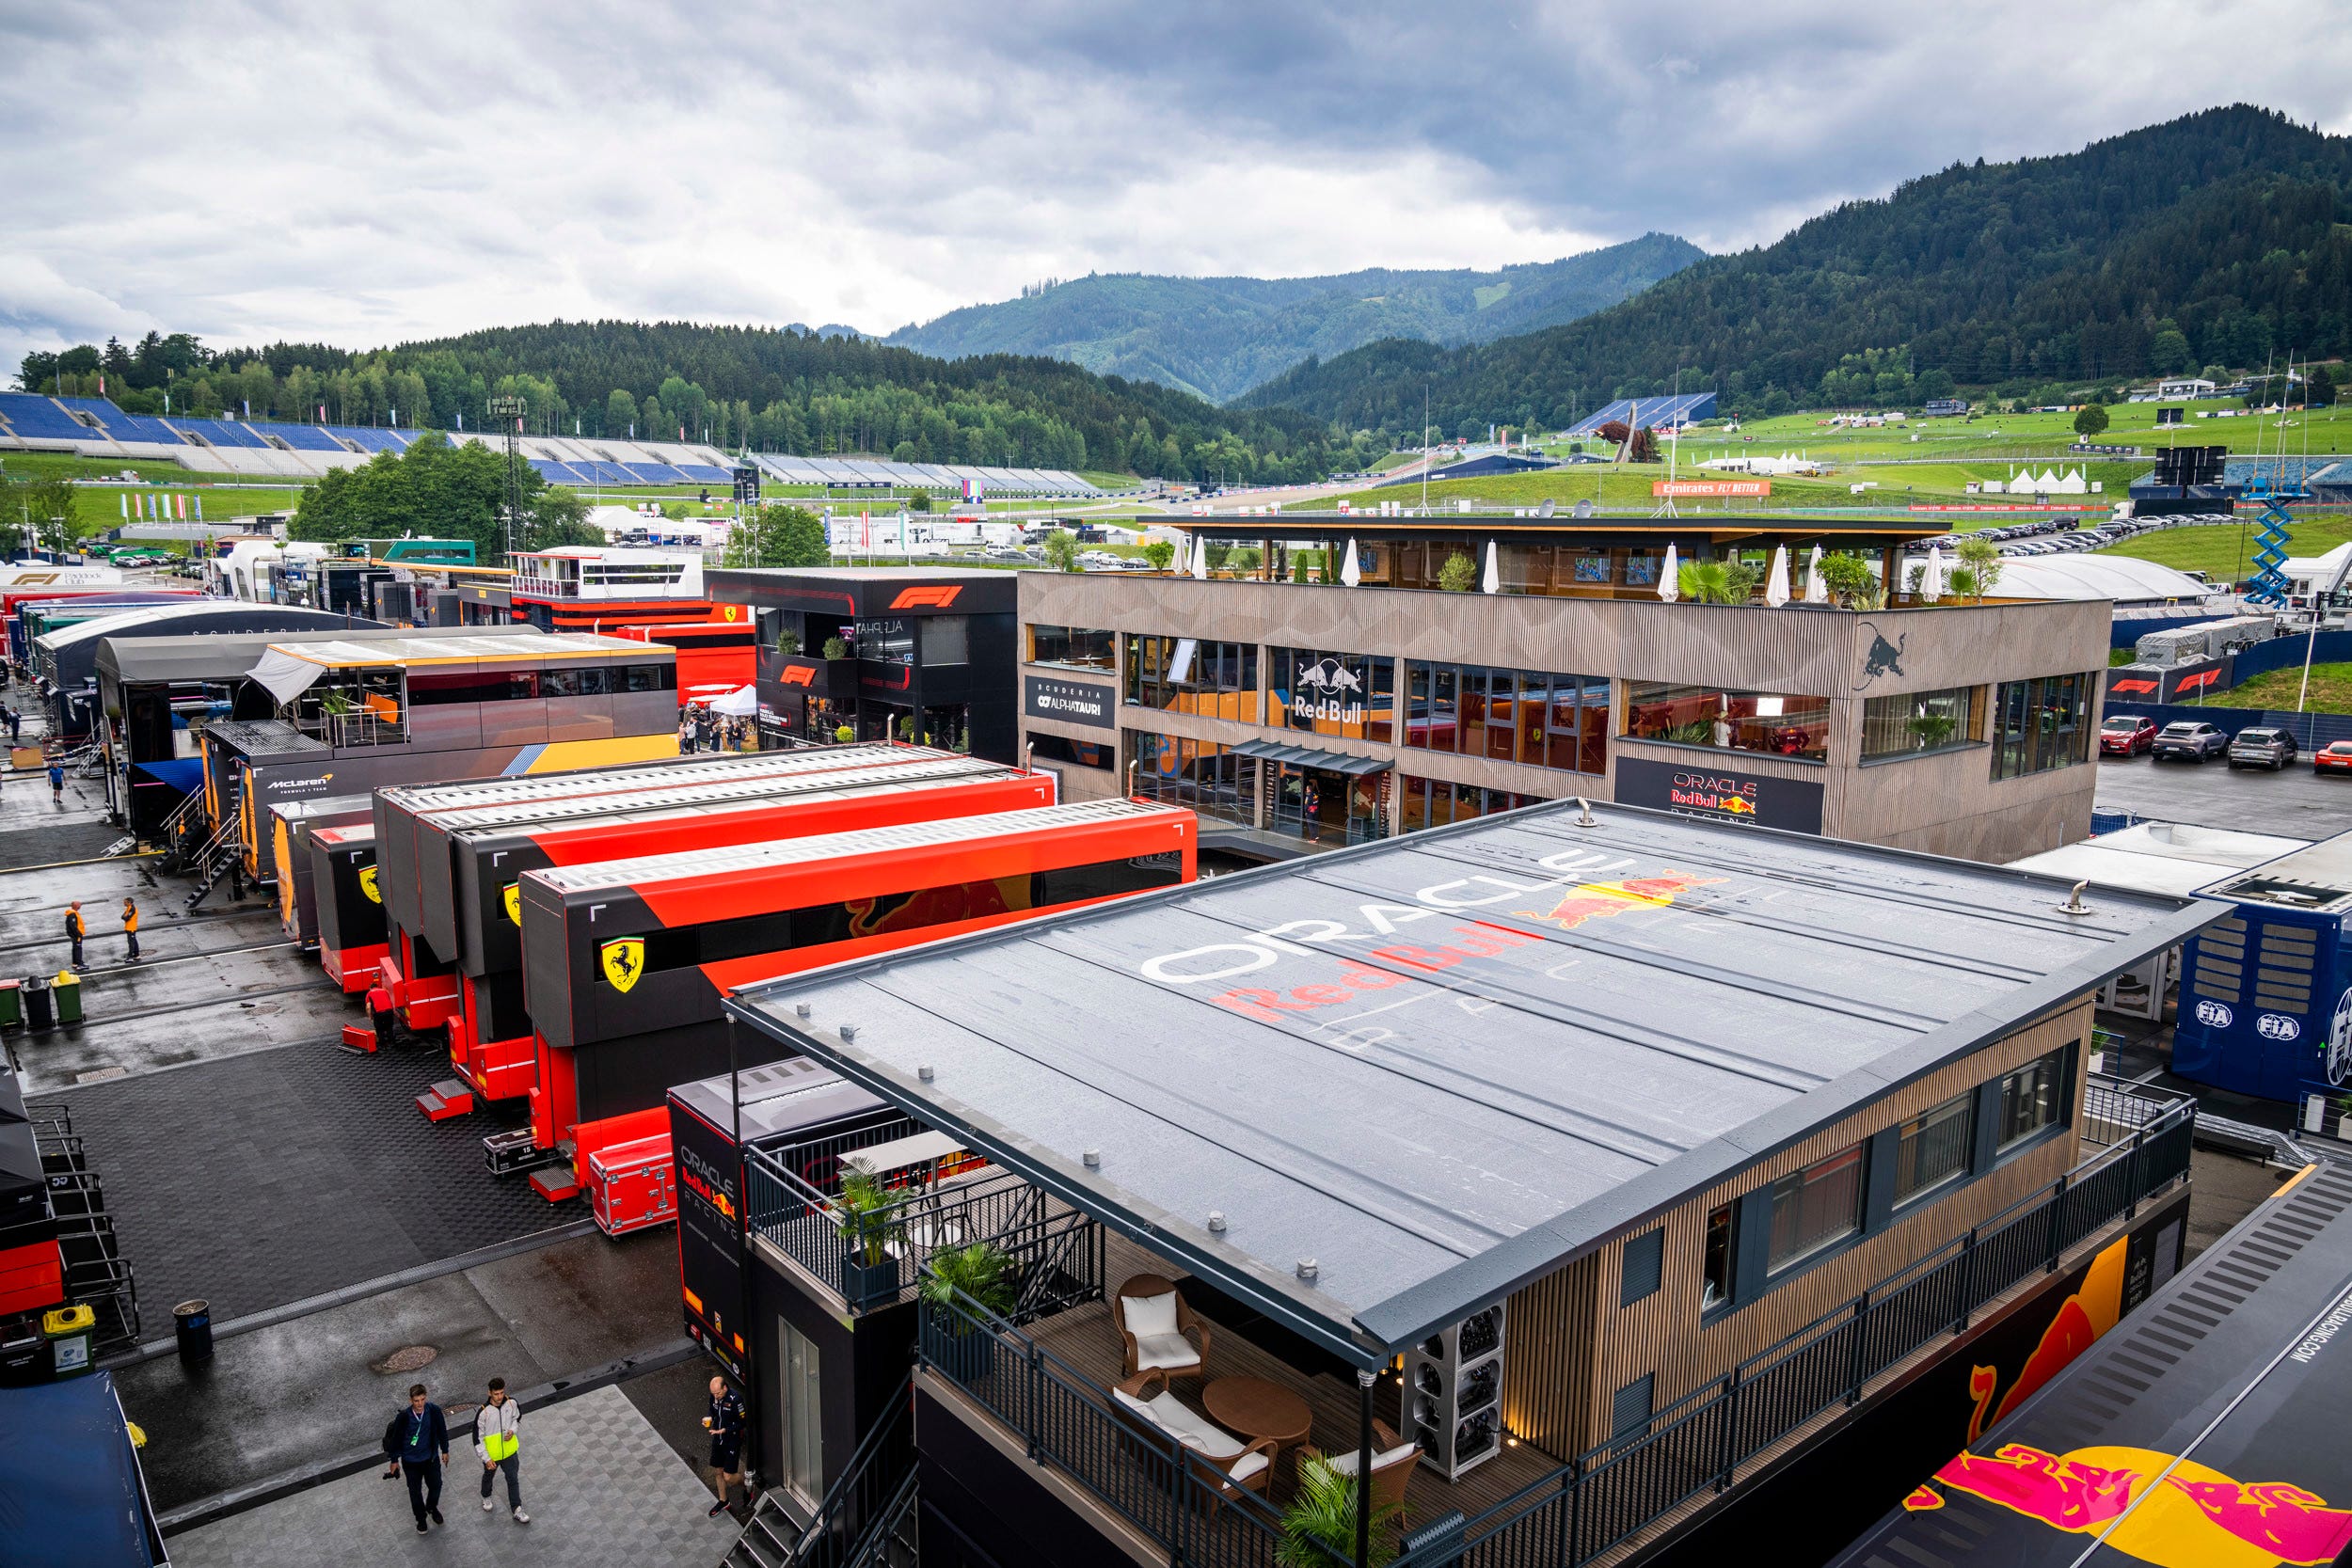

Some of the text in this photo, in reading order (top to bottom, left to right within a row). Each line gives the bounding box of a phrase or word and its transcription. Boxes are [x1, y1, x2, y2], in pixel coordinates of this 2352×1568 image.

[1662, 483, 1760, 494] Emirates FLY BETTER
[1038, 684, 1101, 699] SCUDERIA
[1050, 697, 1101, 716] ALPHATAURI
[1295, 695, 1361, 725] Red Bull
[267, 777, 327, 789] McLaren
[1673, 771, 1757, 798] ORACLE
[1670, 788, 1718, 809] Red Bull
[1140, 848, 1637, 984] ORACLE
[1208, 919, 1547, 1023] Red Bull
[680, 1145, 734, 1198] ORACLE
[682, 1165, 711, 1201] Red Bull
[684, 1190, 738, 1241] RACING
